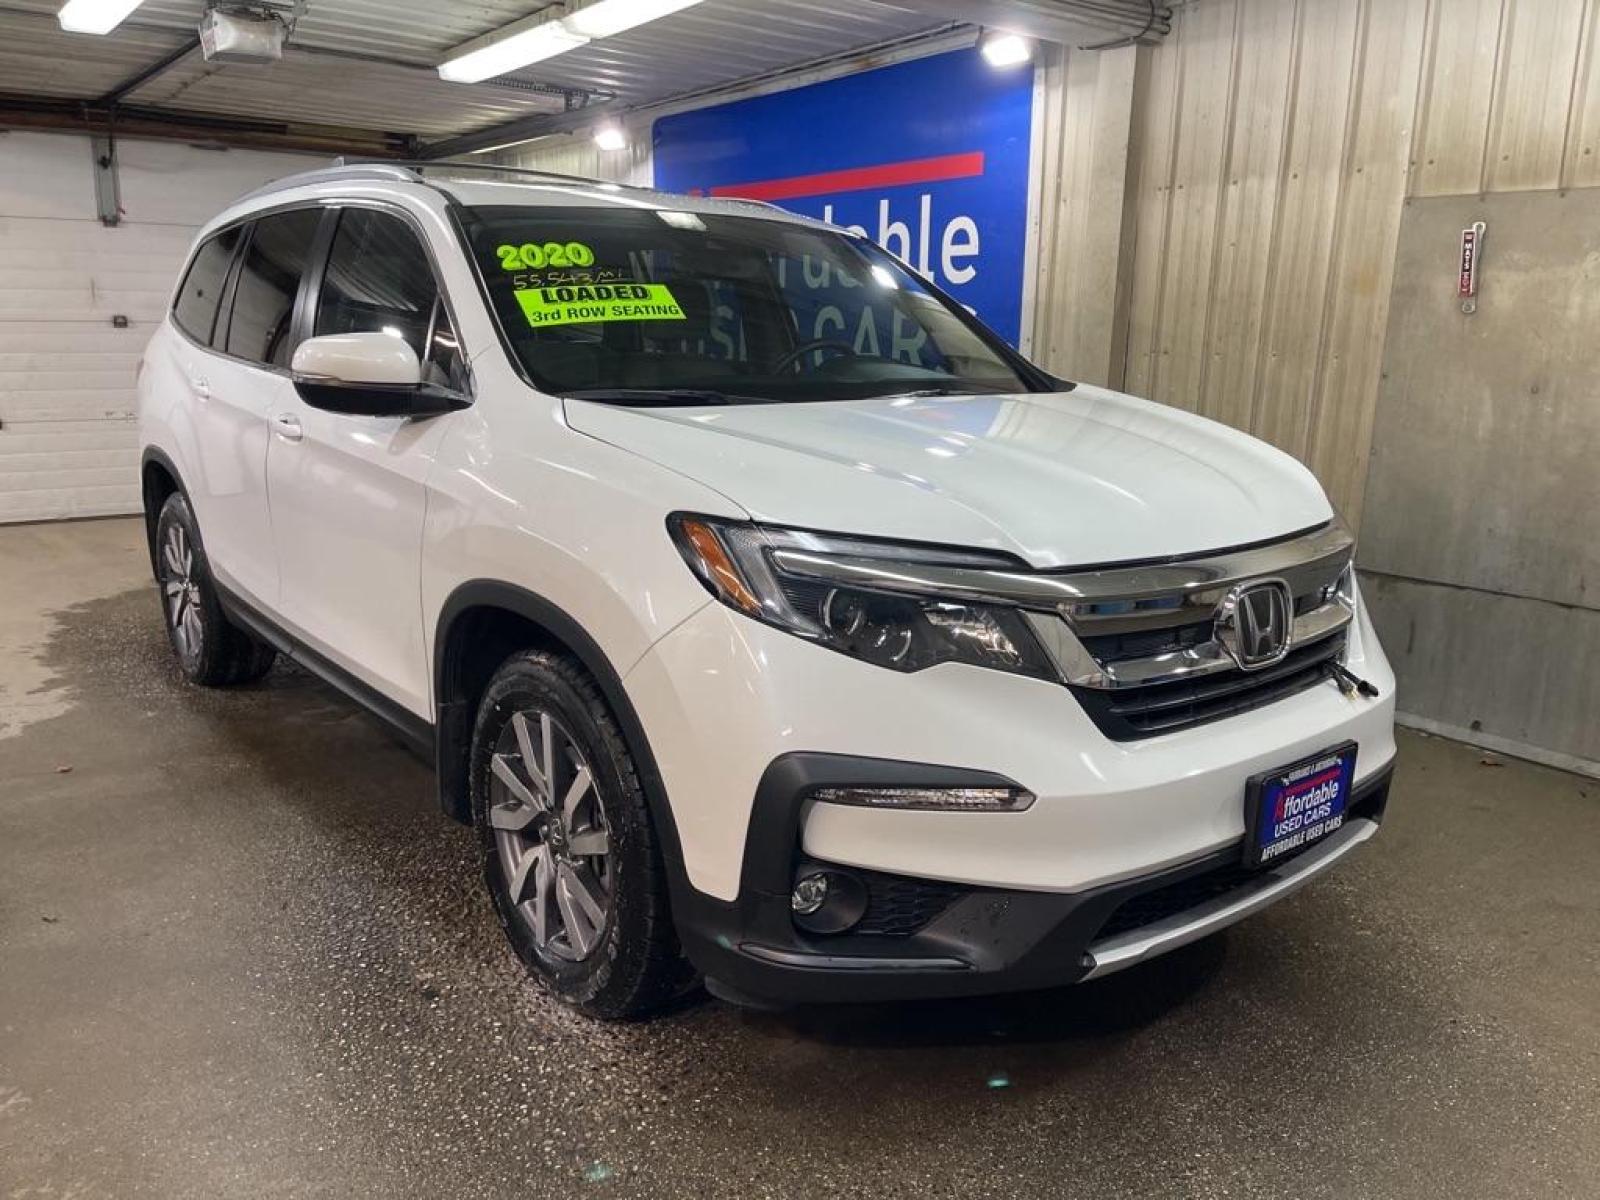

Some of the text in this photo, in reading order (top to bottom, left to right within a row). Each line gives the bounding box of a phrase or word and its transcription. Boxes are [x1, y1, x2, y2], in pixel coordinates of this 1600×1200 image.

[497, 242, 594, 271] 2020
[541, 285, 651, 304] LOADED
[533, 305, 679, 323] 3rd ROW SEATING
[1275, 780, 1339, 822] Affordable
[1275, 802, 1331, 838] USED CARS
[1260, 815, 1343, 862] AFFORDABLE USED CARS
